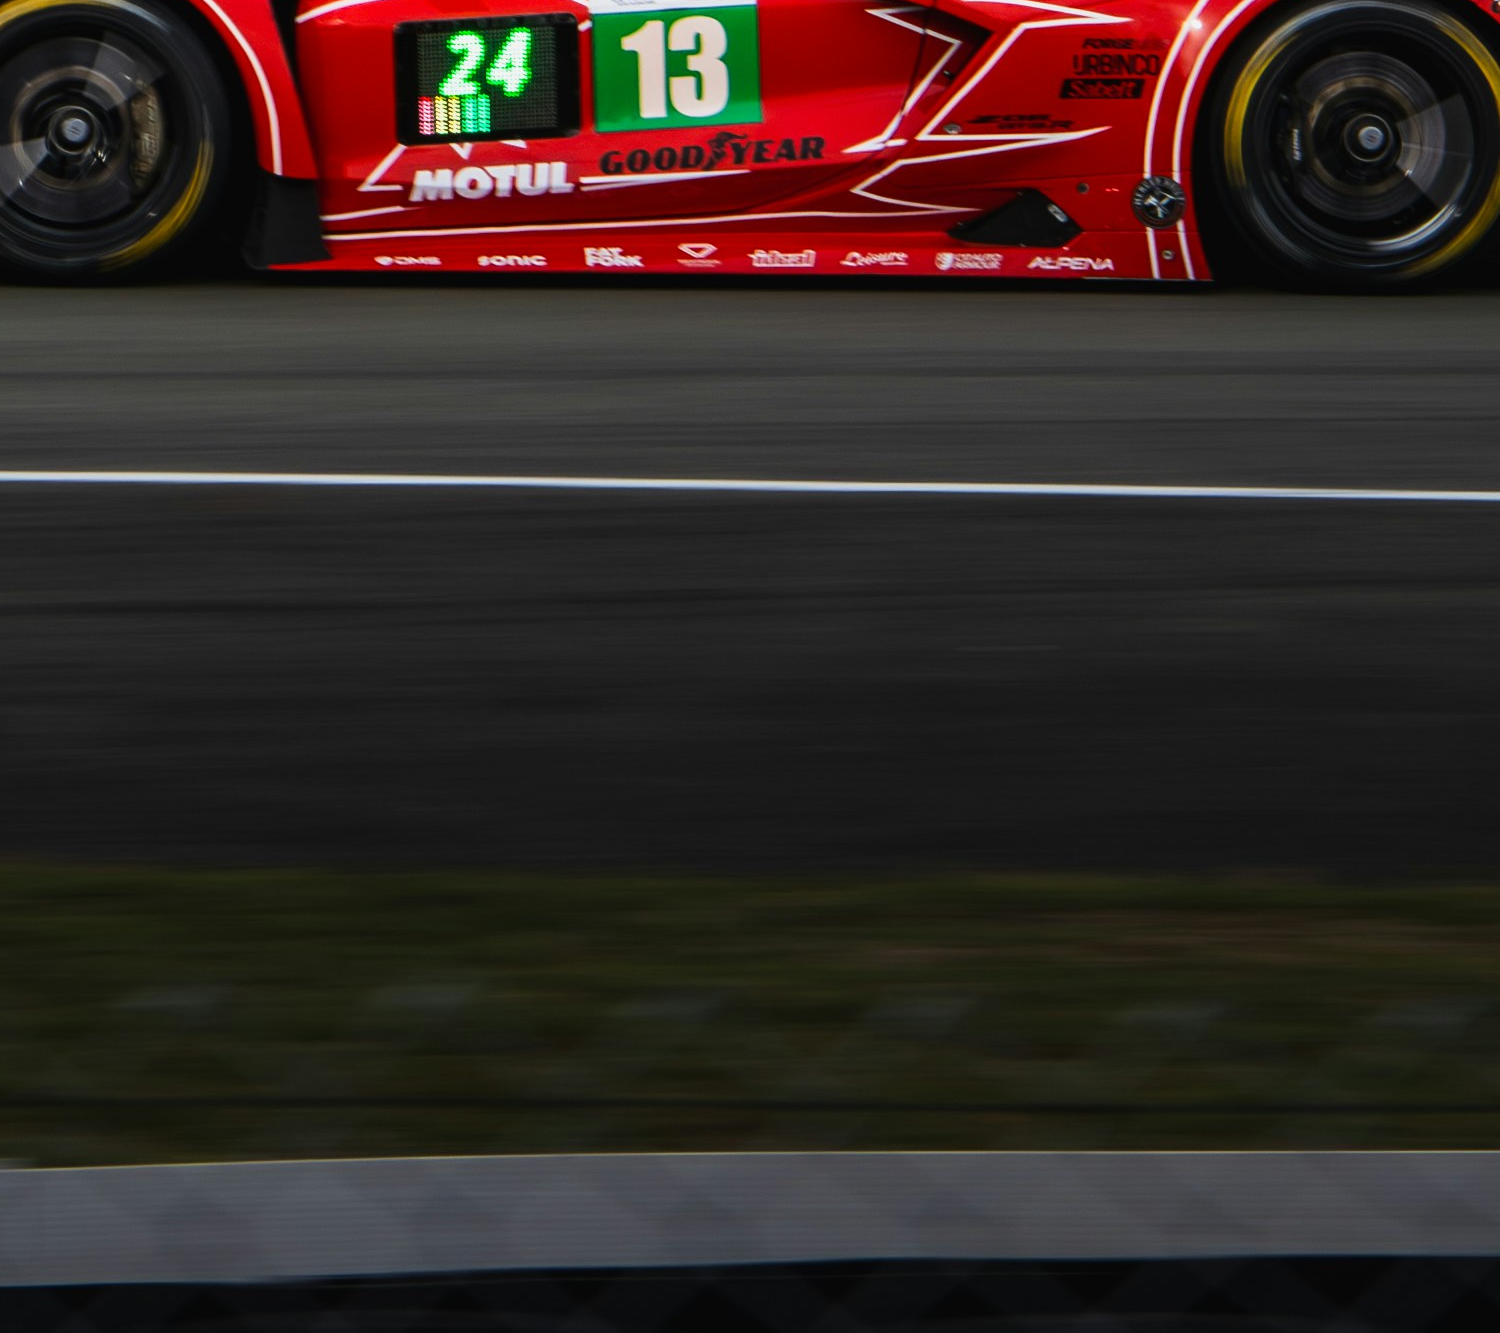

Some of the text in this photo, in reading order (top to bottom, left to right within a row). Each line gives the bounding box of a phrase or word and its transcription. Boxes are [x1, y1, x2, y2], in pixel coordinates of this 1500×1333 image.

[438, 26, 533, 98] 24
[620, 14, 731, 119] 13
[409, 162, 575, 202] MOTUL
[600, 132, 826, 175] GOODYEAR
